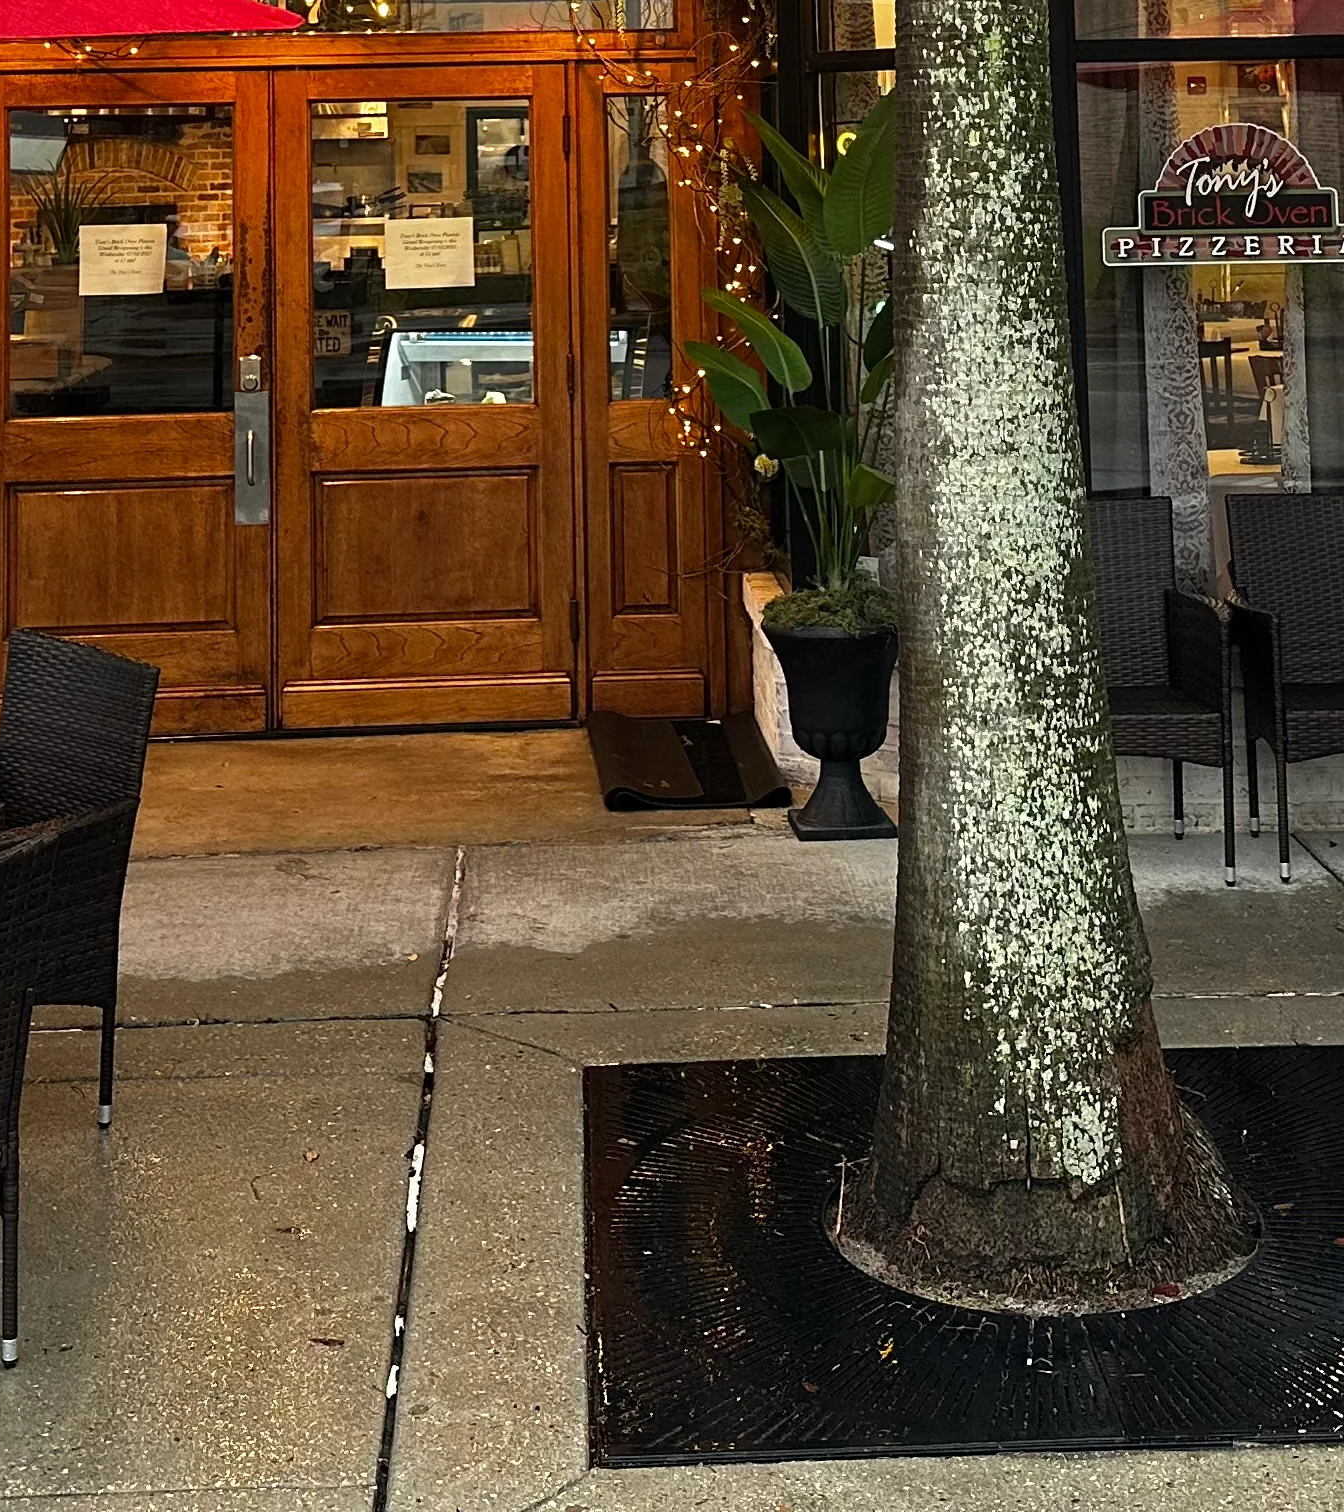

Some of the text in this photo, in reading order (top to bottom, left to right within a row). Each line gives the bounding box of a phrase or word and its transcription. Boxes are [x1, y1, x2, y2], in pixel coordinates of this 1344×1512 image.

[1176, 156, 1284, 218] Tony's
[1152, 194, 1328, 228] Brick Oven
[314, 337, 342, 354] TED
